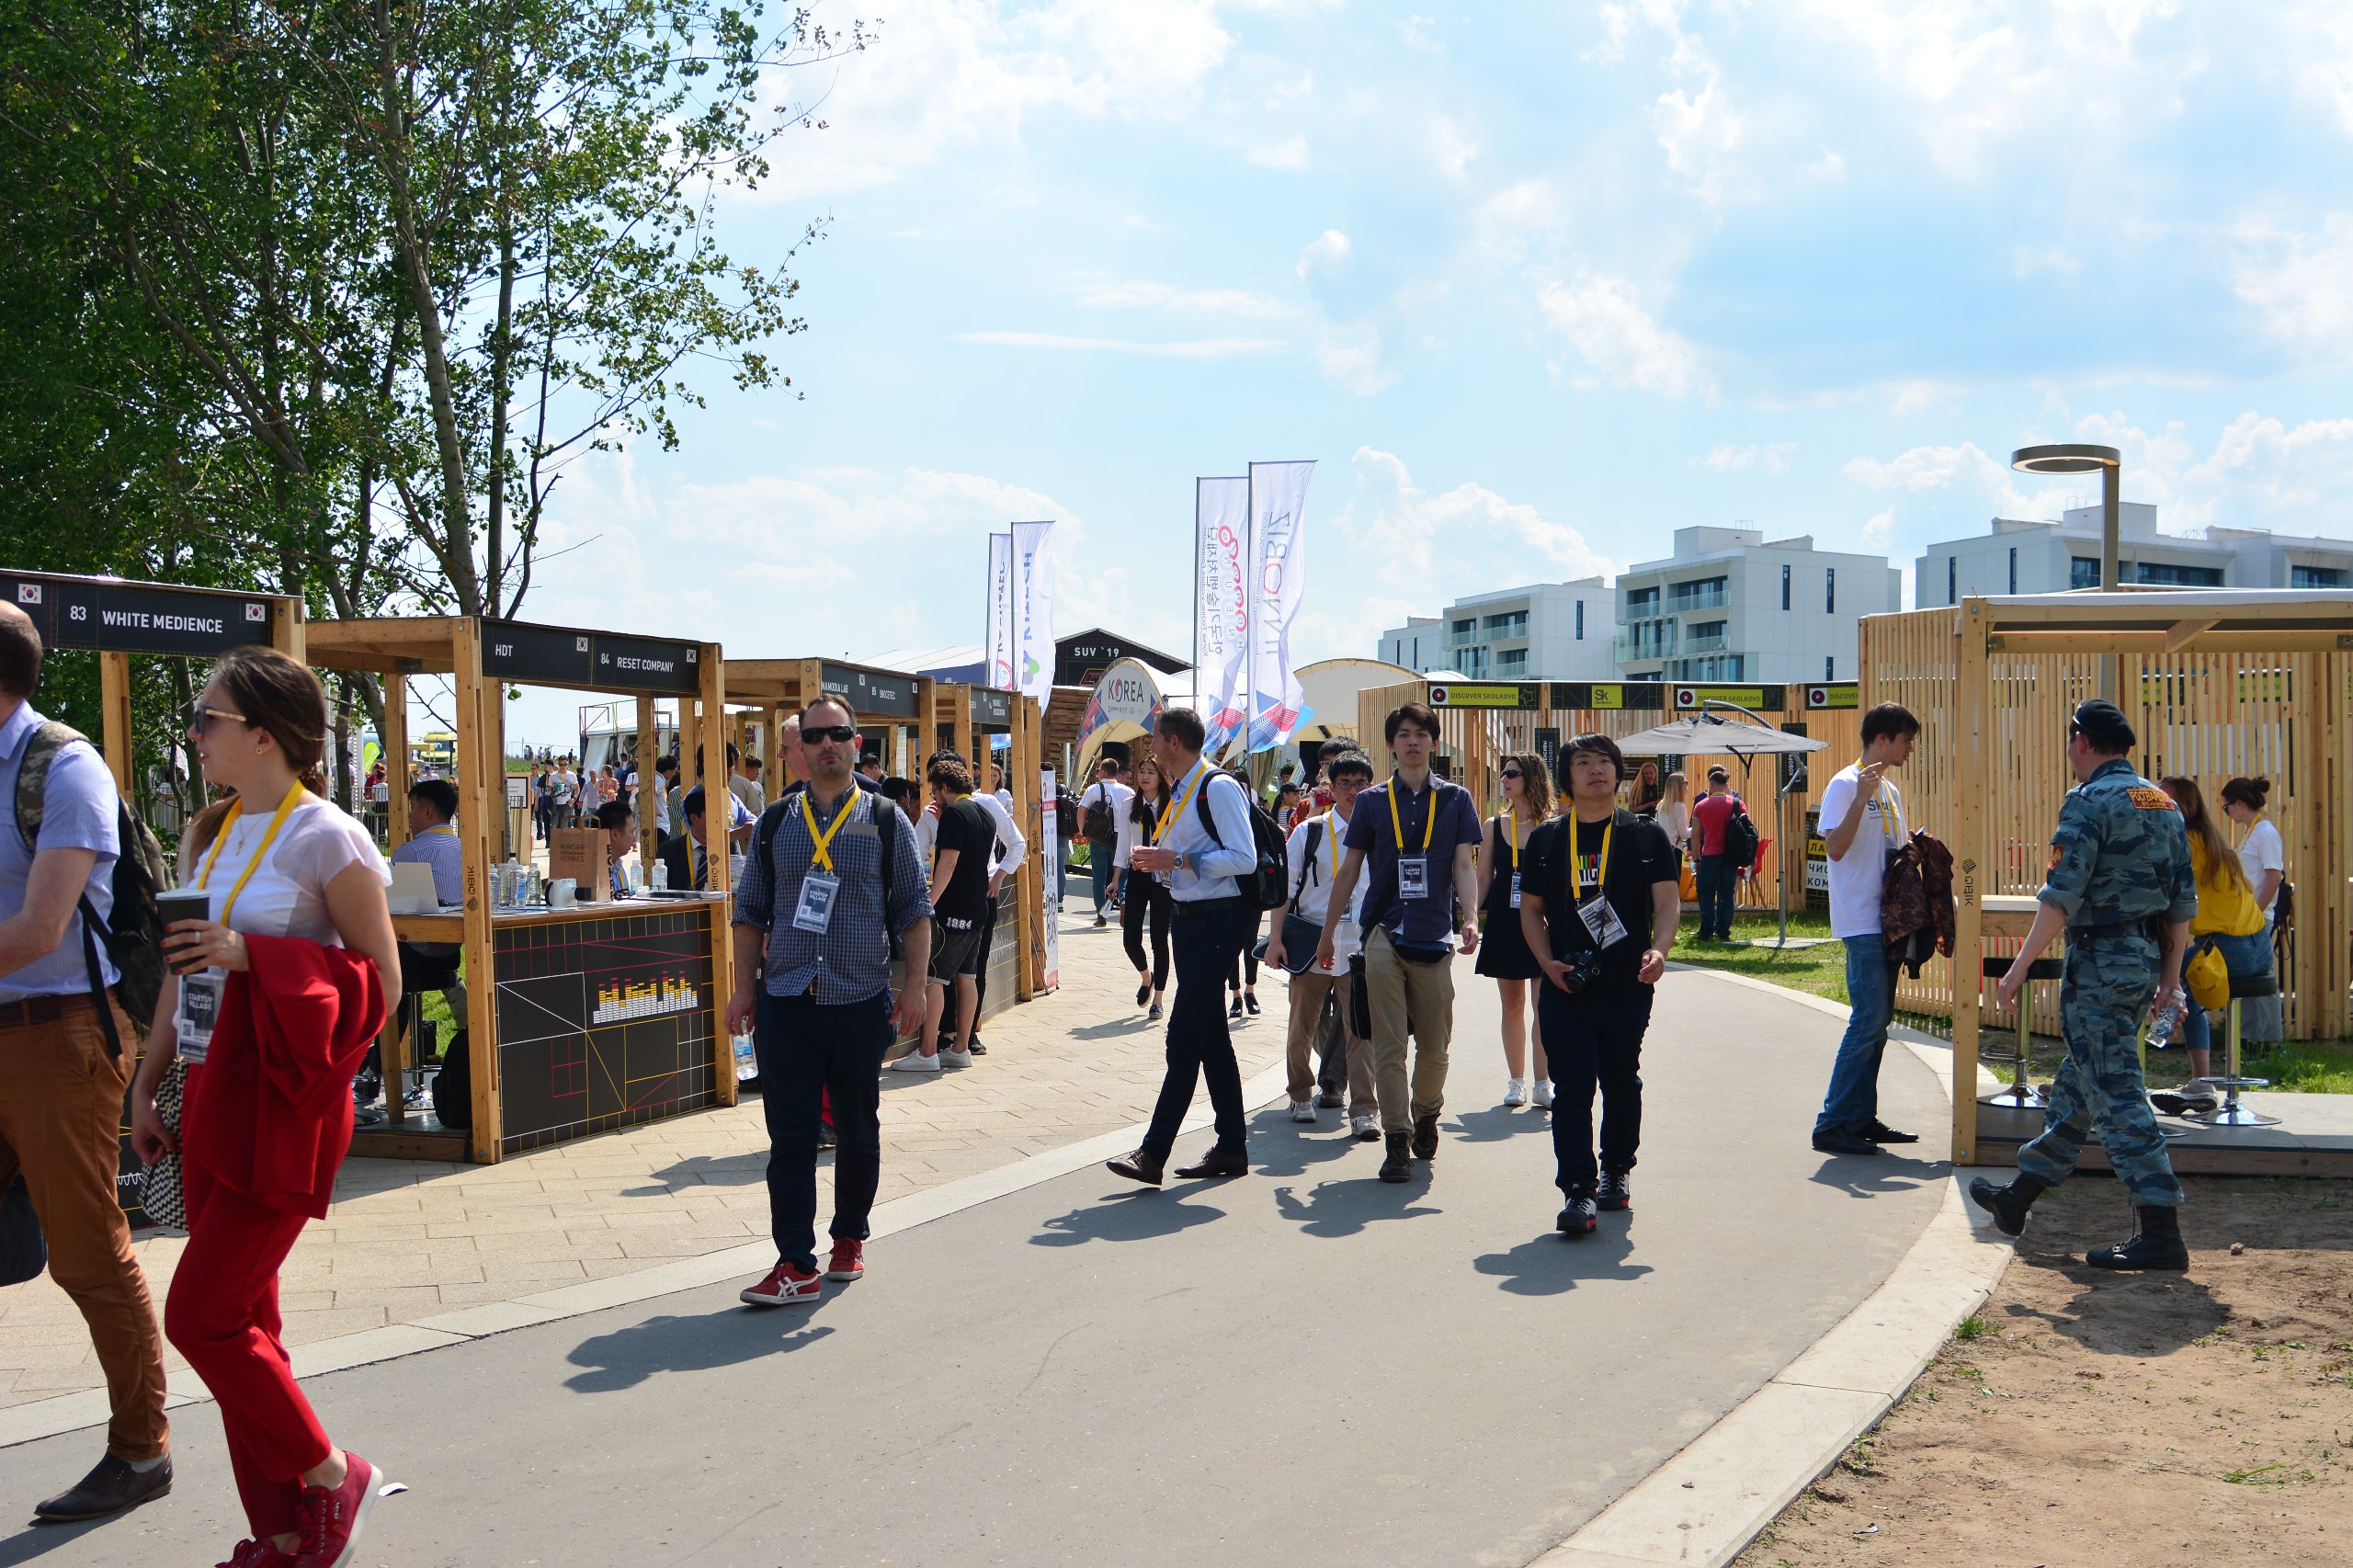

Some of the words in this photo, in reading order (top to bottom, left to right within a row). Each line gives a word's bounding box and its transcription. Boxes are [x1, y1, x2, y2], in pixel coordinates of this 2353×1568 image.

[70, 606, 87, 621] 83
[102, 610, 150, 628] WHITE
[153, 614, 223, 634] MEDIENCE
[494, 644, 514, 657] HDT
[1074, 647, 1097, 657] SUV
[600, 653, 610, 665] 84
[617, 656, 642, 670] RESET
[642, 659, 675, 673] COMPANY
[1108, 677, 1144, 703] KOREA
[1595, 688, 1608, 701] Sk
[1698, 694, 1727, 702] DISCOVER
[467, 865, 476, 895] QBIK
[809, 890, 829, 898] STARTUP
[809, 894, 827, 903] VILLAGE
[947, 916, 972, 929] 1984
[188, 993, 214, 1003] STARTUP
[188, 1000, 213, 1010] VILLAGE
